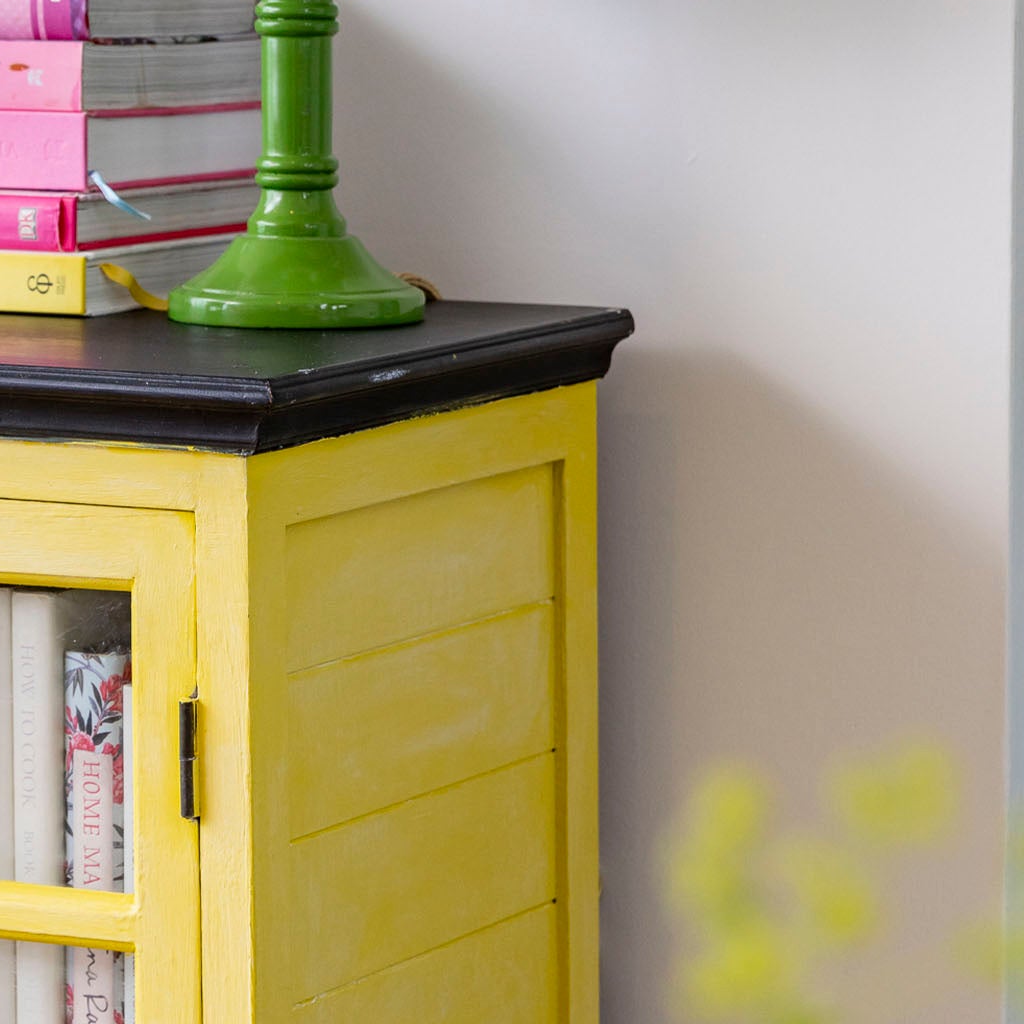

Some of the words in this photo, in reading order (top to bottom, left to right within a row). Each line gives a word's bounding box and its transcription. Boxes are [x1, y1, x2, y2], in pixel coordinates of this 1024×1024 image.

[20, 644, 36, 699] HOW
[21, 707, 36, 737] TO
[21, 742, 37, 809] COOK
[82, 759, 100, 836] HOME
